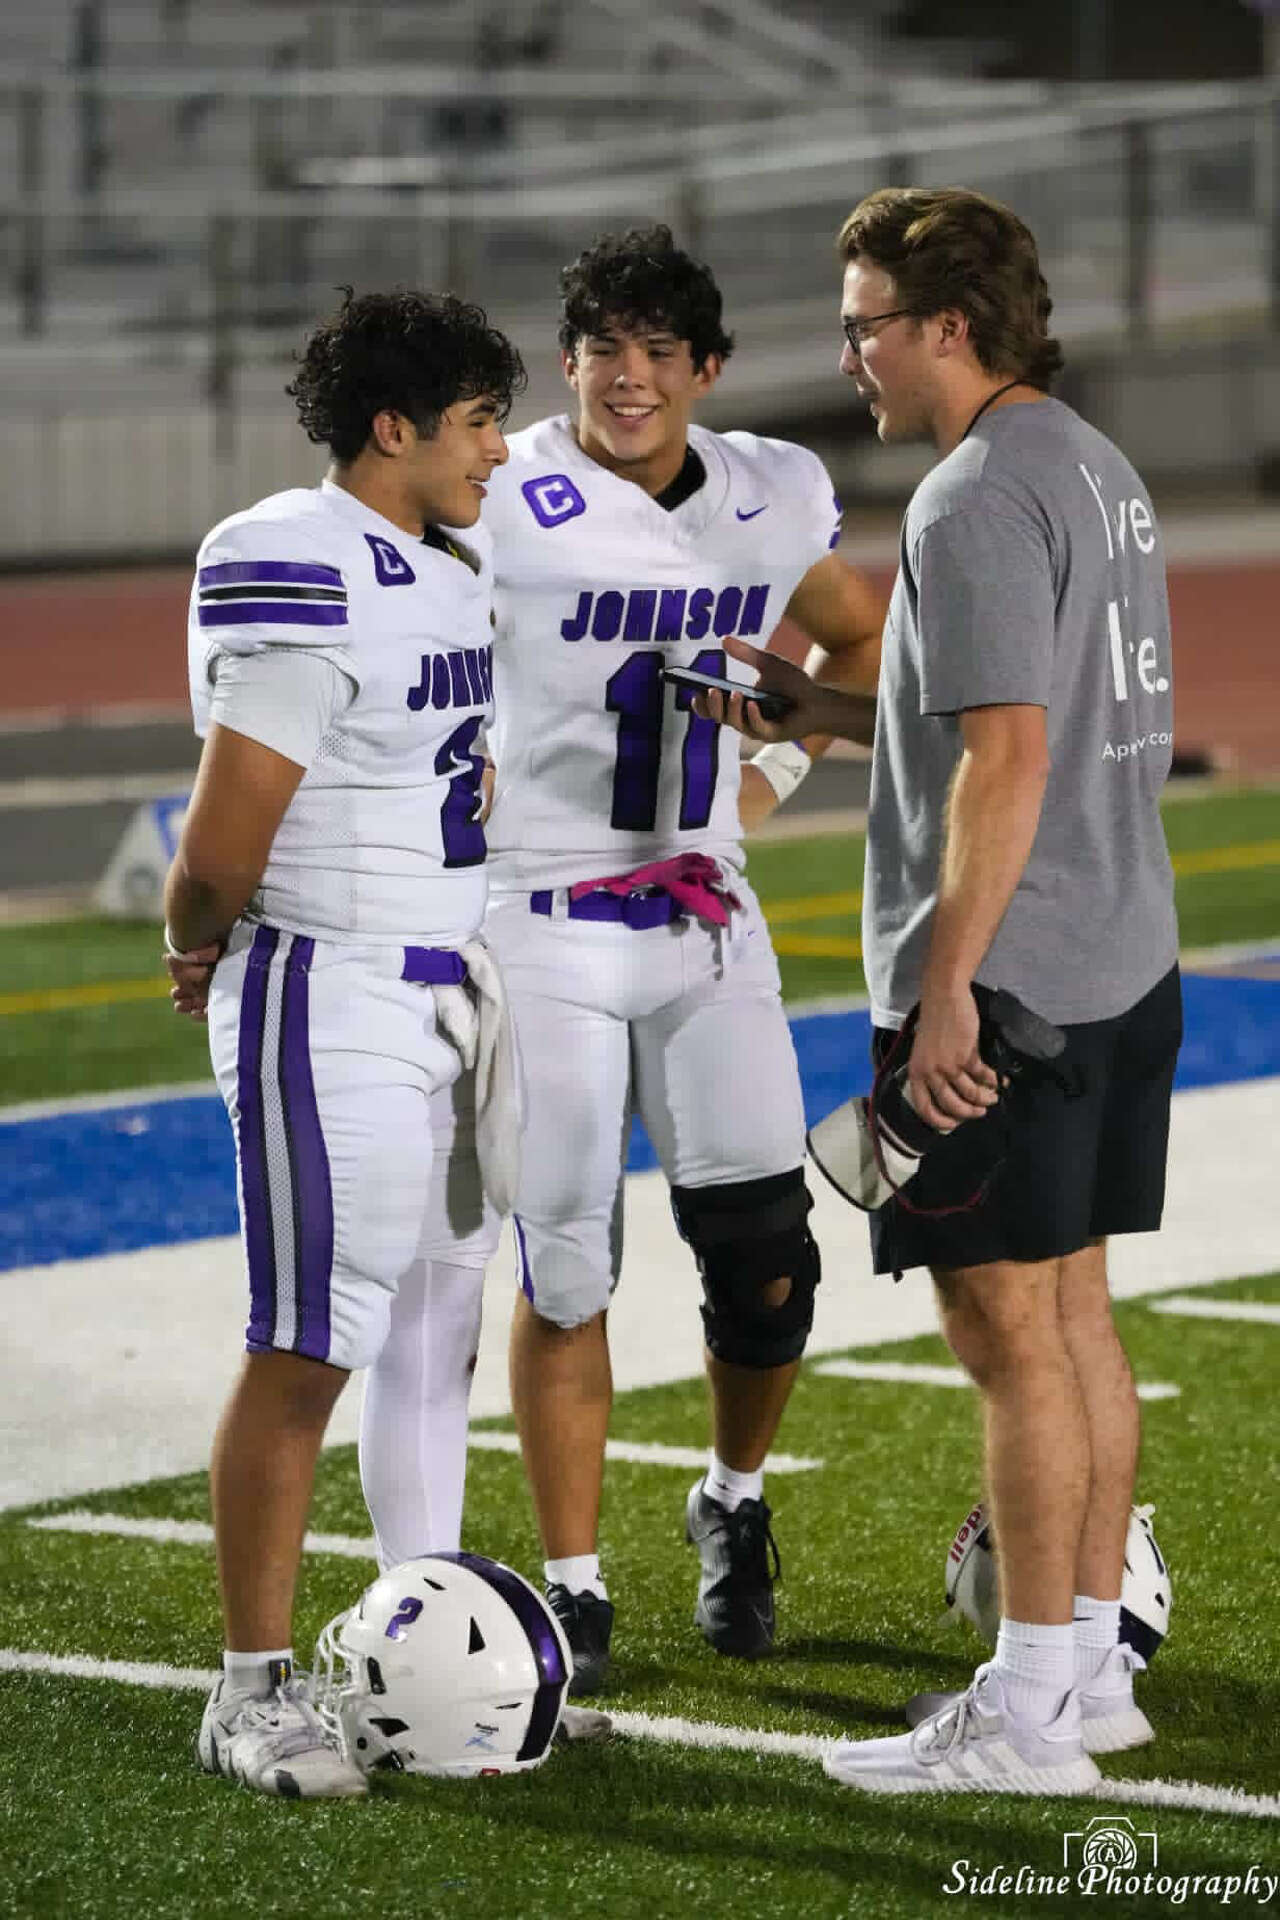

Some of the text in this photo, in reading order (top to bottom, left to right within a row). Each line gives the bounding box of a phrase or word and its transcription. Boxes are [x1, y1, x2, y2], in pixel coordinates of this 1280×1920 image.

[534, 481, 574, 517] C
[560, 584, 771, 643] JOHNSON
[605, 649, 728, 832] 11
[950, 1509, 981, 1563] dell
[385, 1597, 424, 1641] 2
